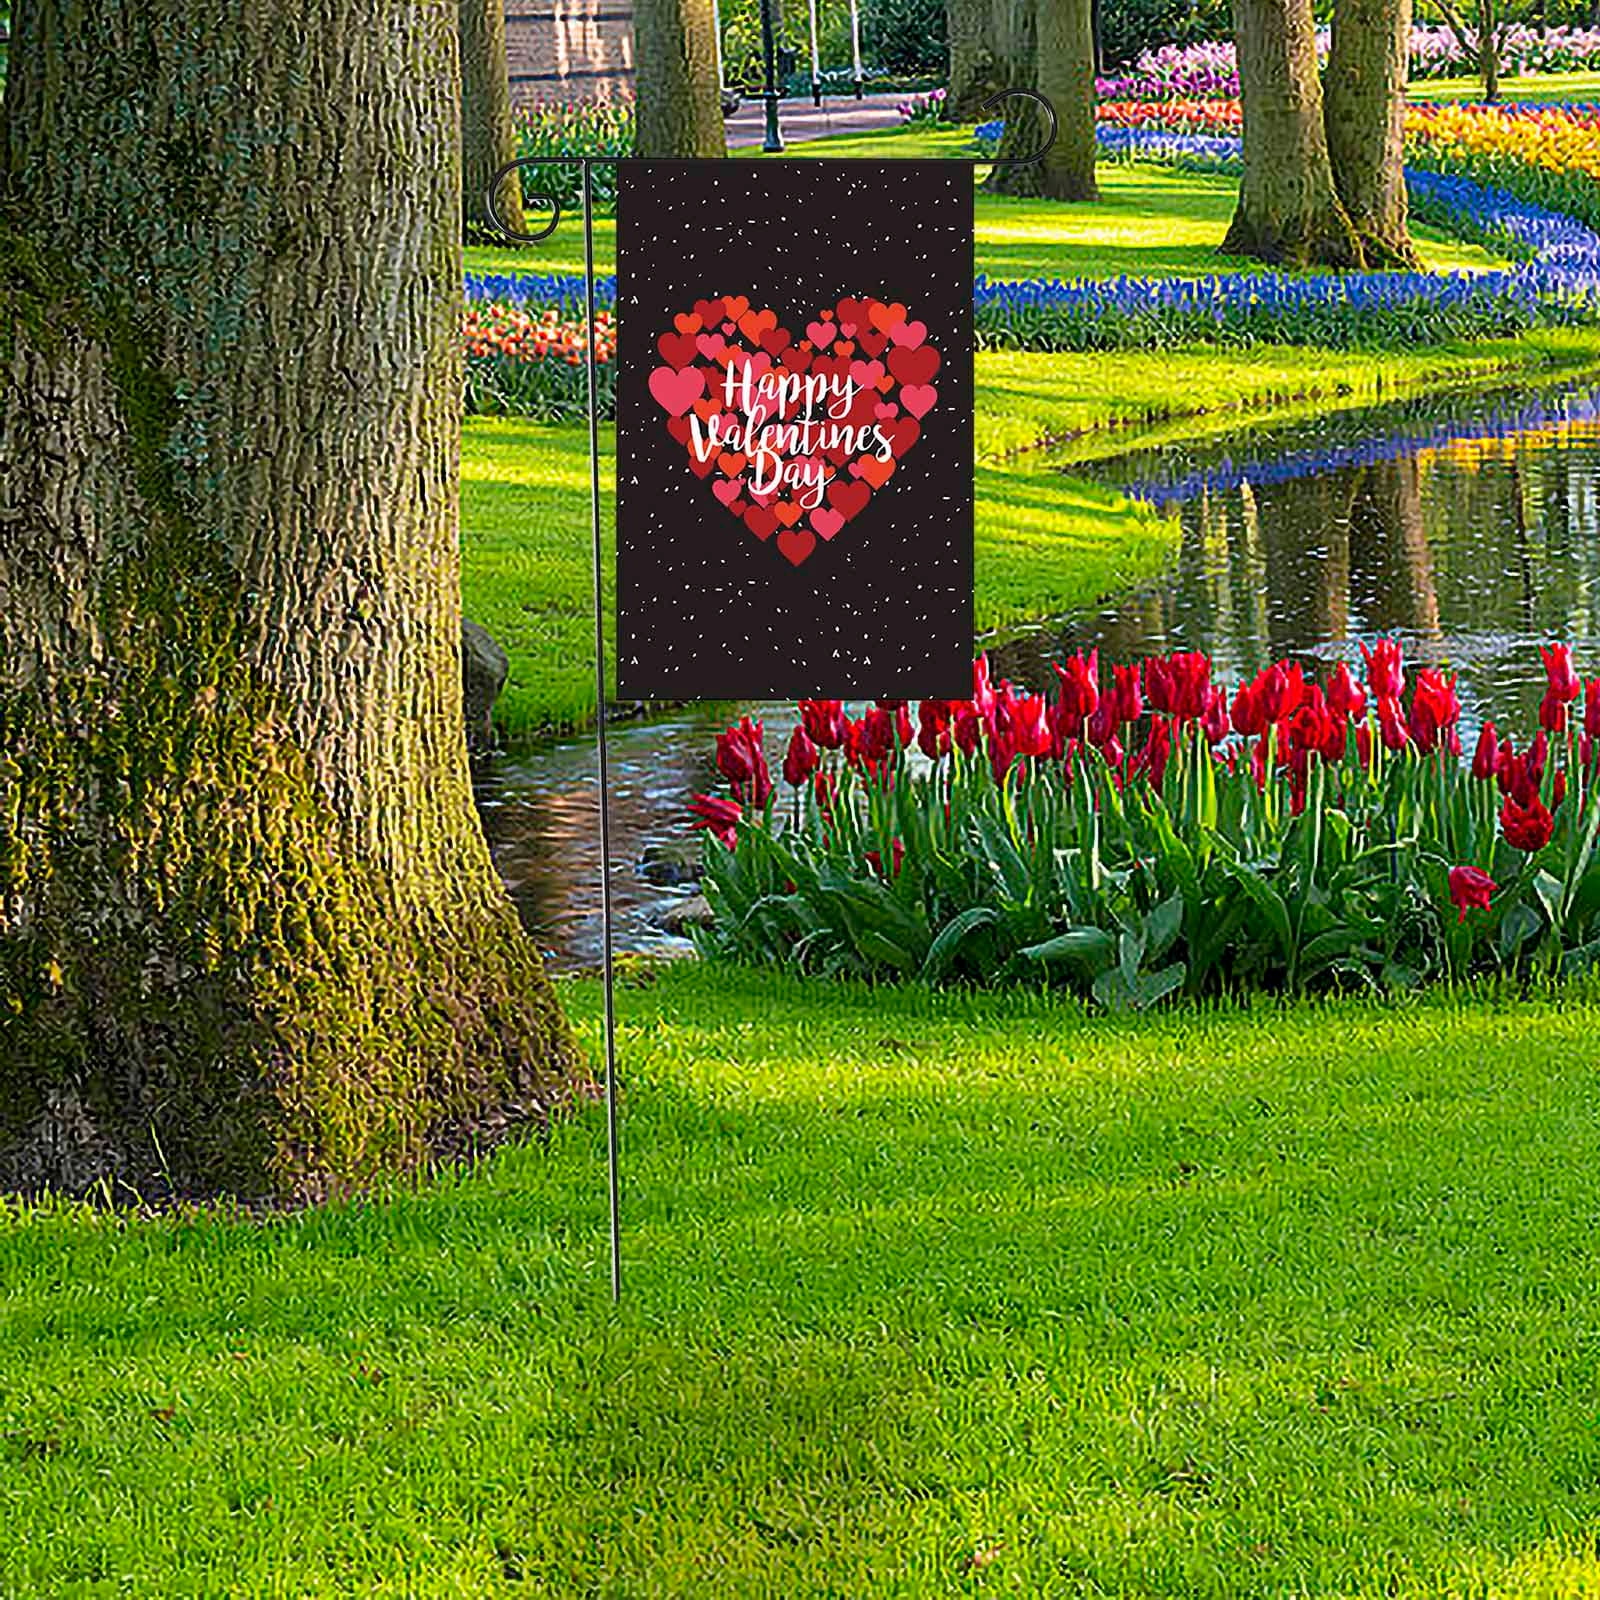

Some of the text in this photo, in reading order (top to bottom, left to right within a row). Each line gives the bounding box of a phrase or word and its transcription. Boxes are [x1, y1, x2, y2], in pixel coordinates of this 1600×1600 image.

[720, 359, 864, 419] Happy
[689, 404, 895, 463] Valentines
[748, 449, 836, 509] Day
